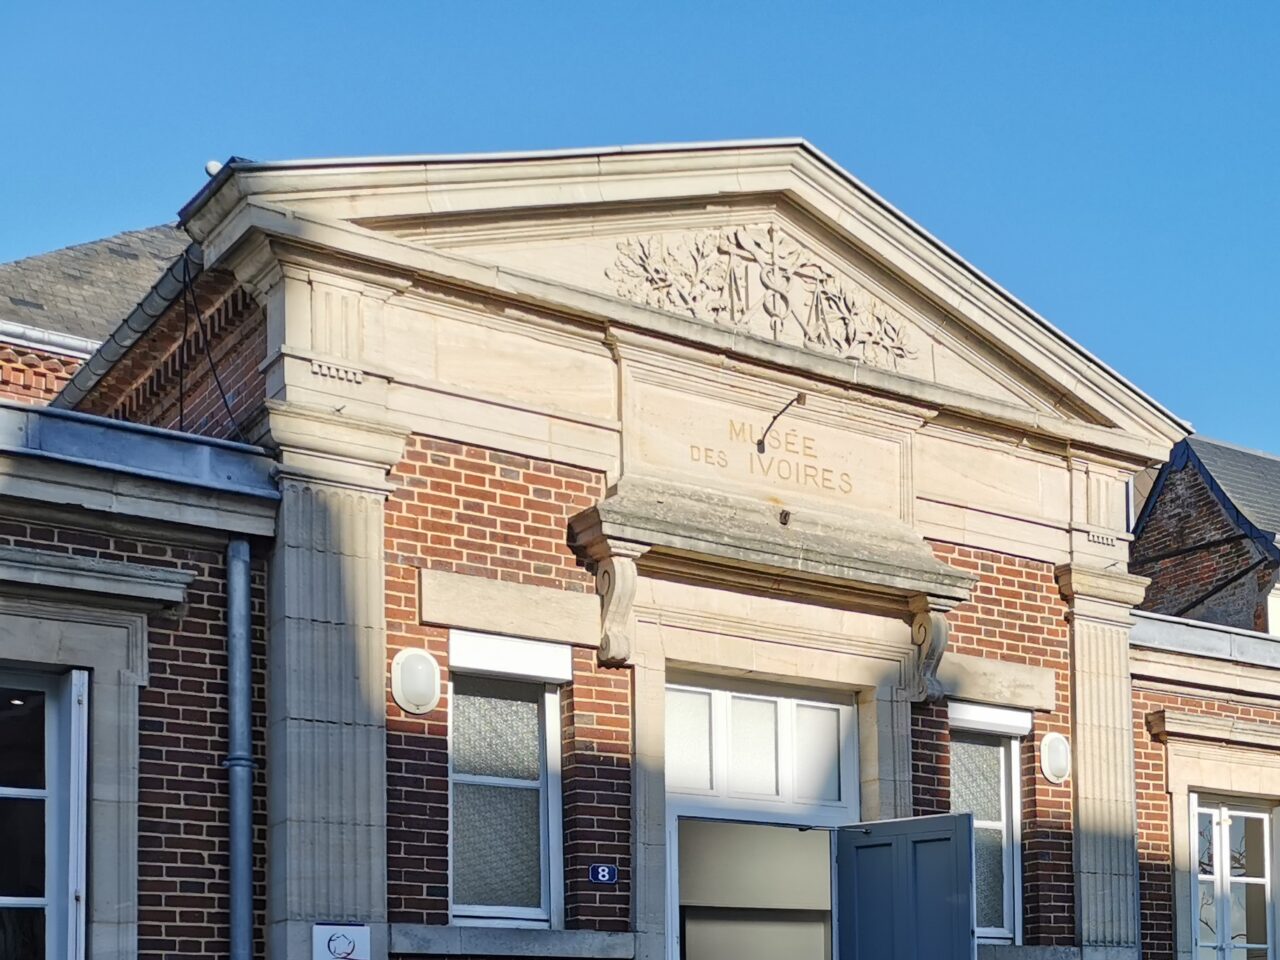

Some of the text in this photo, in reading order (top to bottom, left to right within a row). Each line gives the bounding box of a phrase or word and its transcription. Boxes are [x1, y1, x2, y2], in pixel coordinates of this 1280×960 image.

[729, 419, 818, 459] MUSÉE
[690, 445, 854, 494] DES IVOIRES
[598, 866, 609, 881] 8
